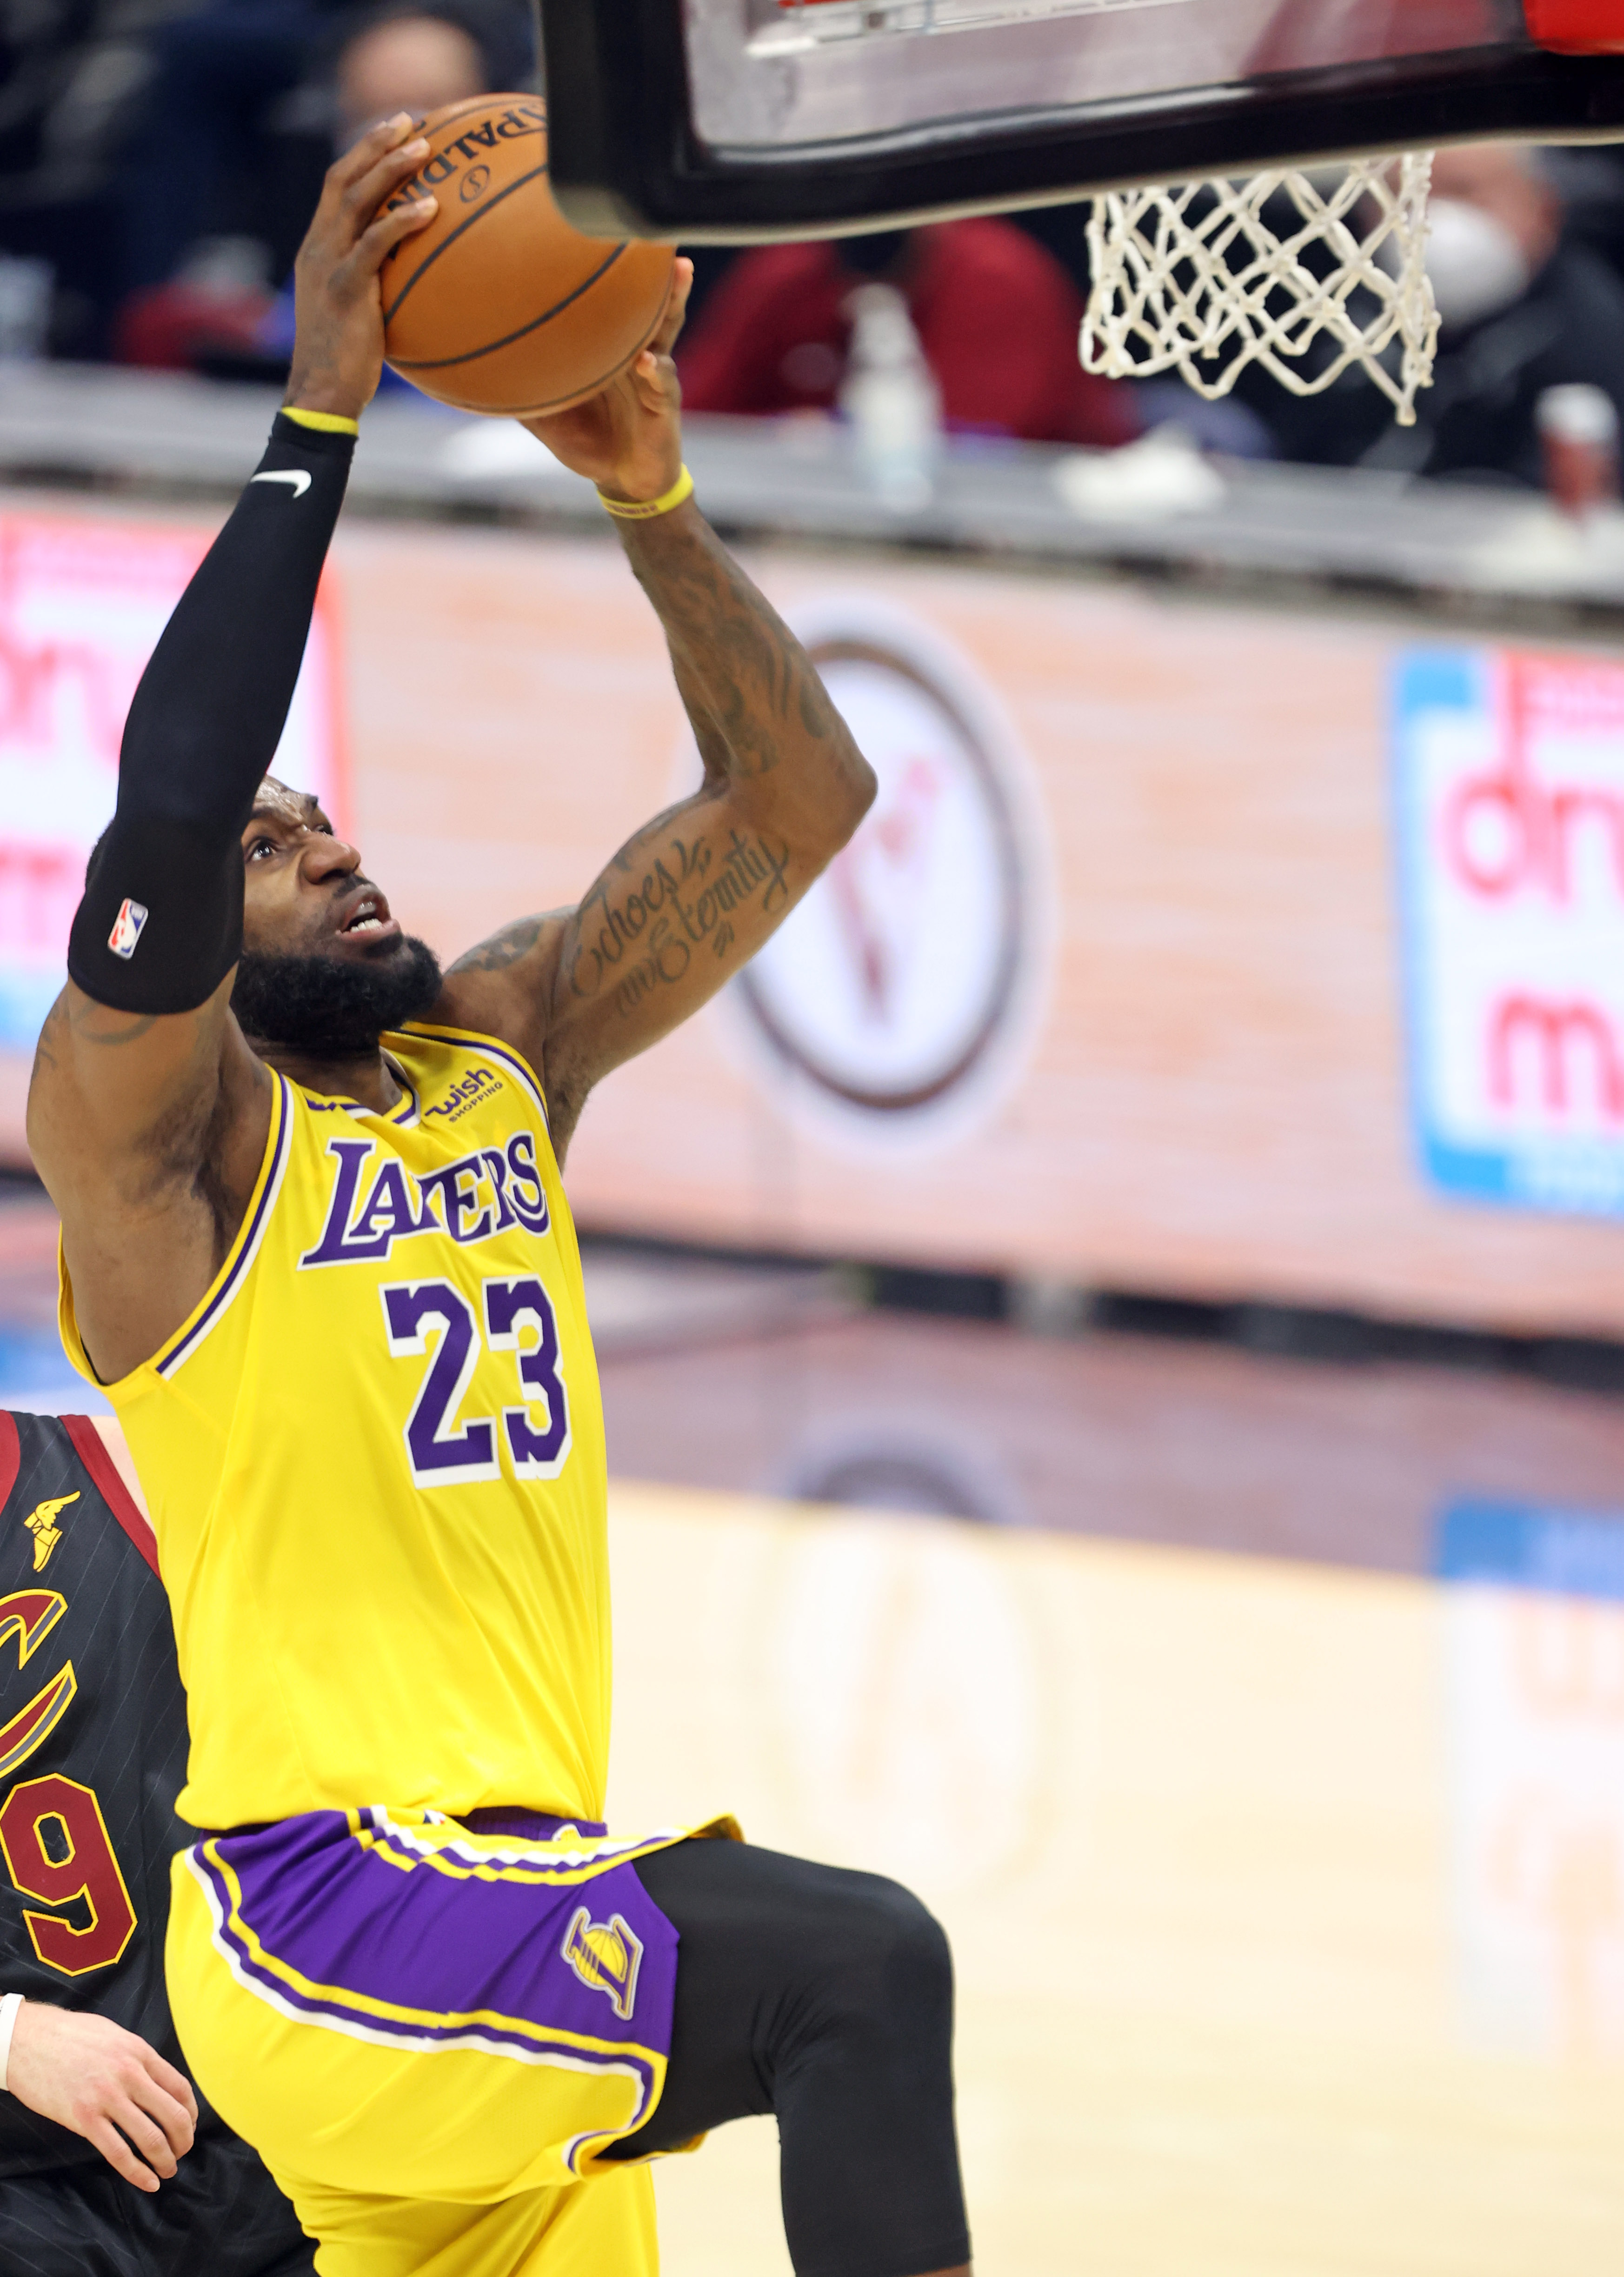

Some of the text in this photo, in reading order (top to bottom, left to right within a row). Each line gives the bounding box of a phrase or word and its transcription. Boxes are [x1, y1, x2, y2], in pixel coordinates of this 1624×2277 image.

[386, 106, 546, 213] PALDIN
[424, 1068, 494, 1116] wish
[448, 1081, 503, 1123] SHOPPING
[379, 1273, 572, 1488] 23
[0, 1773, 138, 1976] 9
